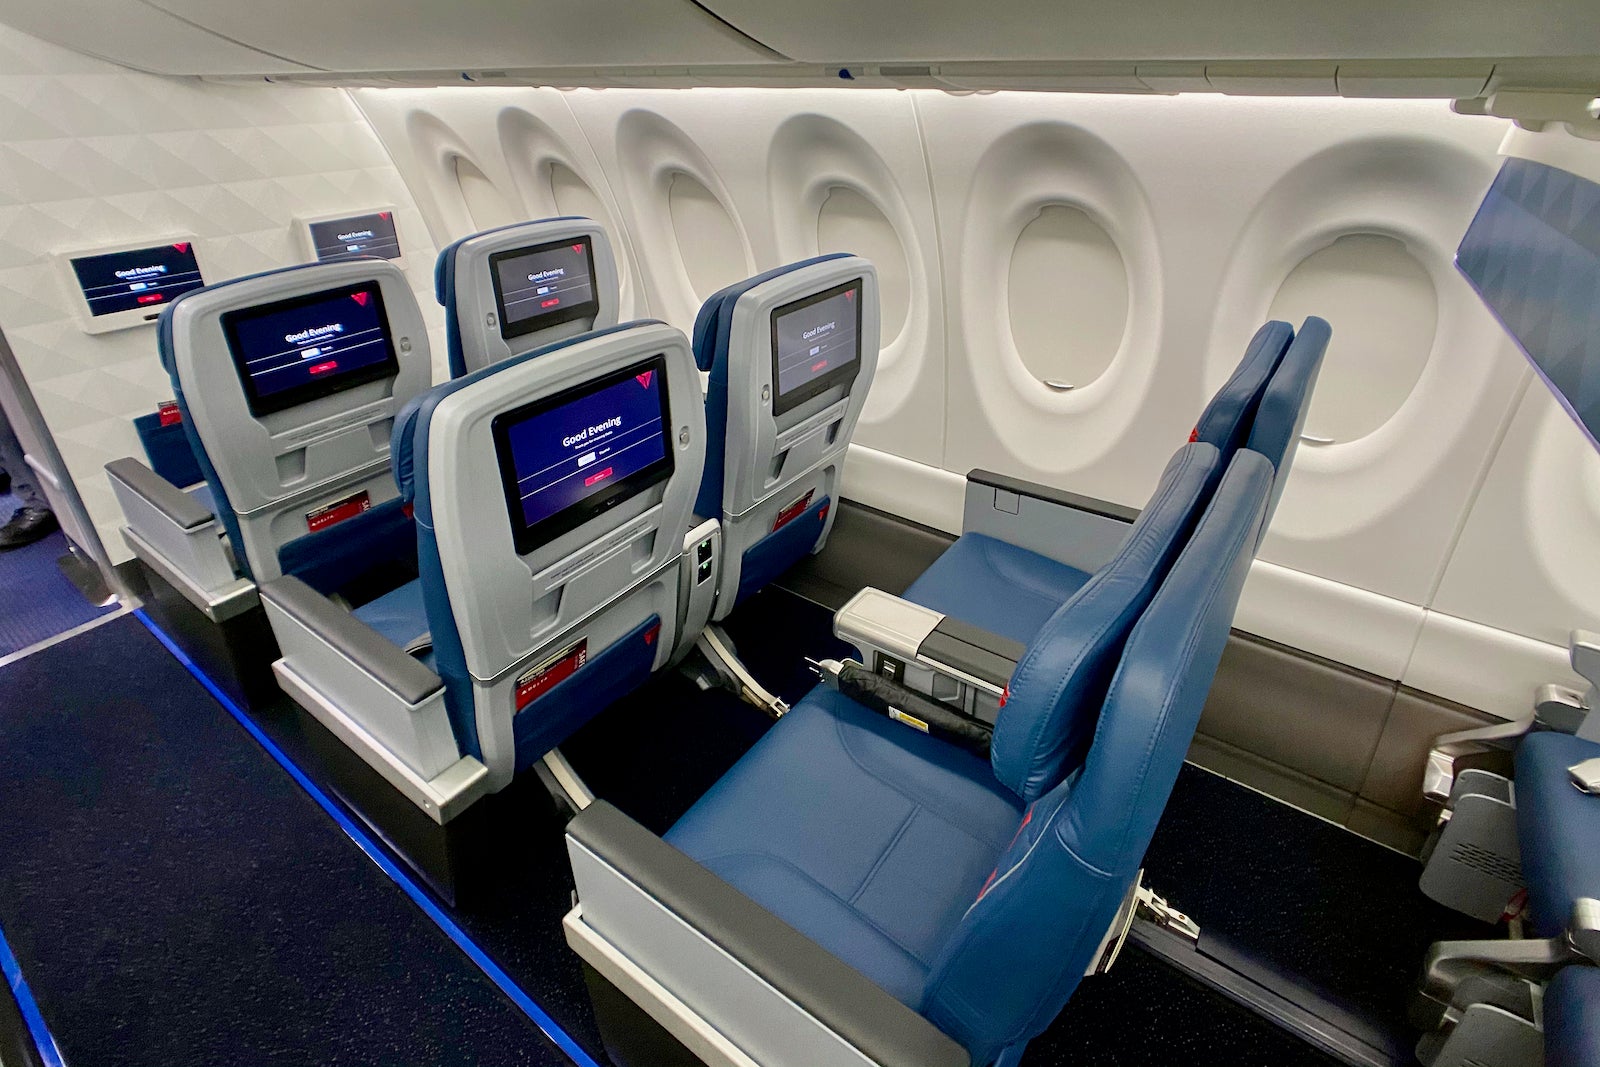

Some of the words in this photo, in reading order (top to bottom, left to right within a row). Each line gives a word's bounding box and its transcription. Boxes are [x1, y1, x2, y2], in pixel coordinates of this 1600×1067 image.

[352, 230, 372, 238] Evening
[115, 269, 136, 278] Good
[136, 265, 165, 274] Evening
[528, 272, 542, 280] Good
[543, 269, 563, 278] Evening
[285, 330, 308, 343] Good
[308, 323, 341, 337] Evening
[803, 328, 816, 339] Good
[817, 322, 835, 333] Evening
[563, 429, 587, 446] Good
[588, 416, 621, 436] Evening
